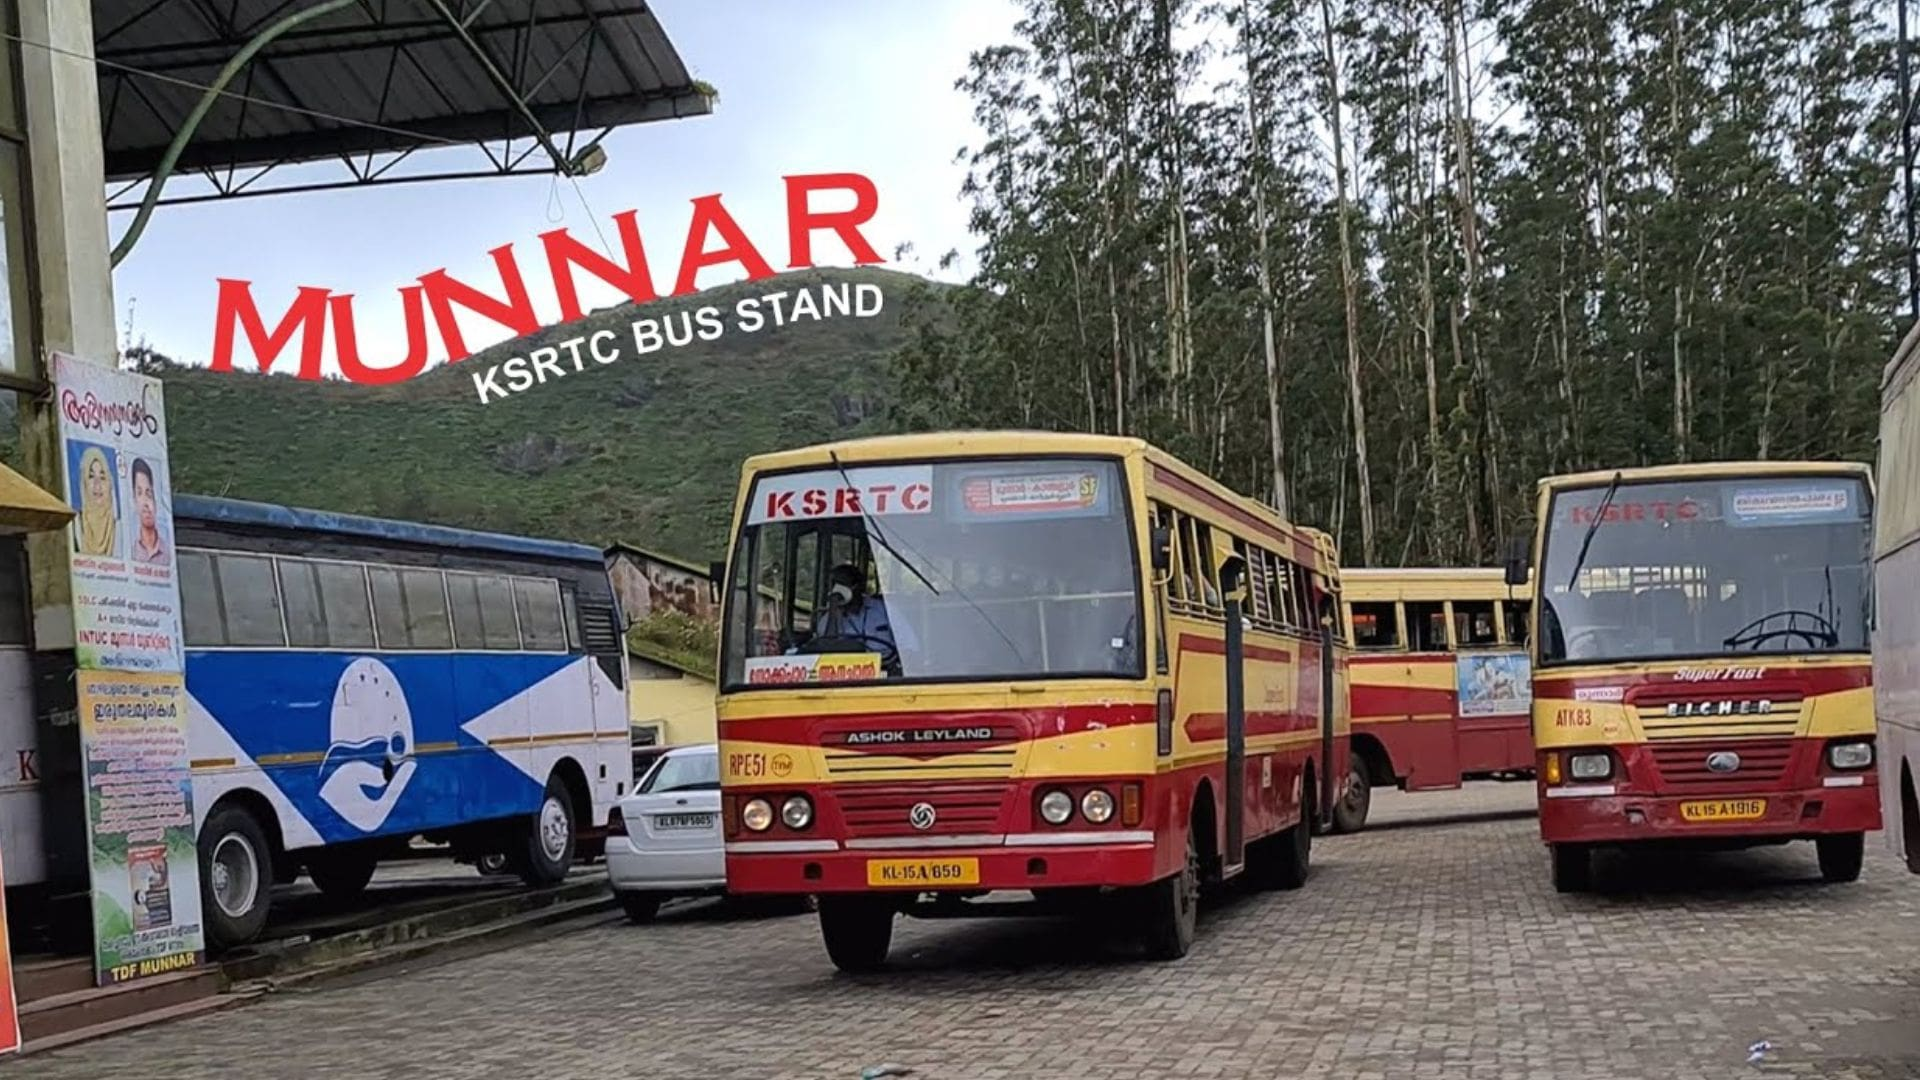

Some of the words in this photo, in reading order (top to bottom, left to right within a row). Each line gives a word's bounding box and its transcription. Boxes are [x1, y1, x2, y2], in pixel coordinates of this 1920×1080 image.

[766, 483, 931, 518] KSRTC
[1571, 500, 1698, 523] KSRTC
[79, 630, 107, 644] INTUC
[1556, 708, 1592, 727] ATK83
[1667, 700, 1771, 717] EICHER
[848, 731, 905, 743] ASHOK
[914, 728, 991, 740] LEYLAND
[729, 753, 766, 776] RPE51
[111, 962, 138, 981] TDF
[140, 952, 196, 975] MUNNAR
